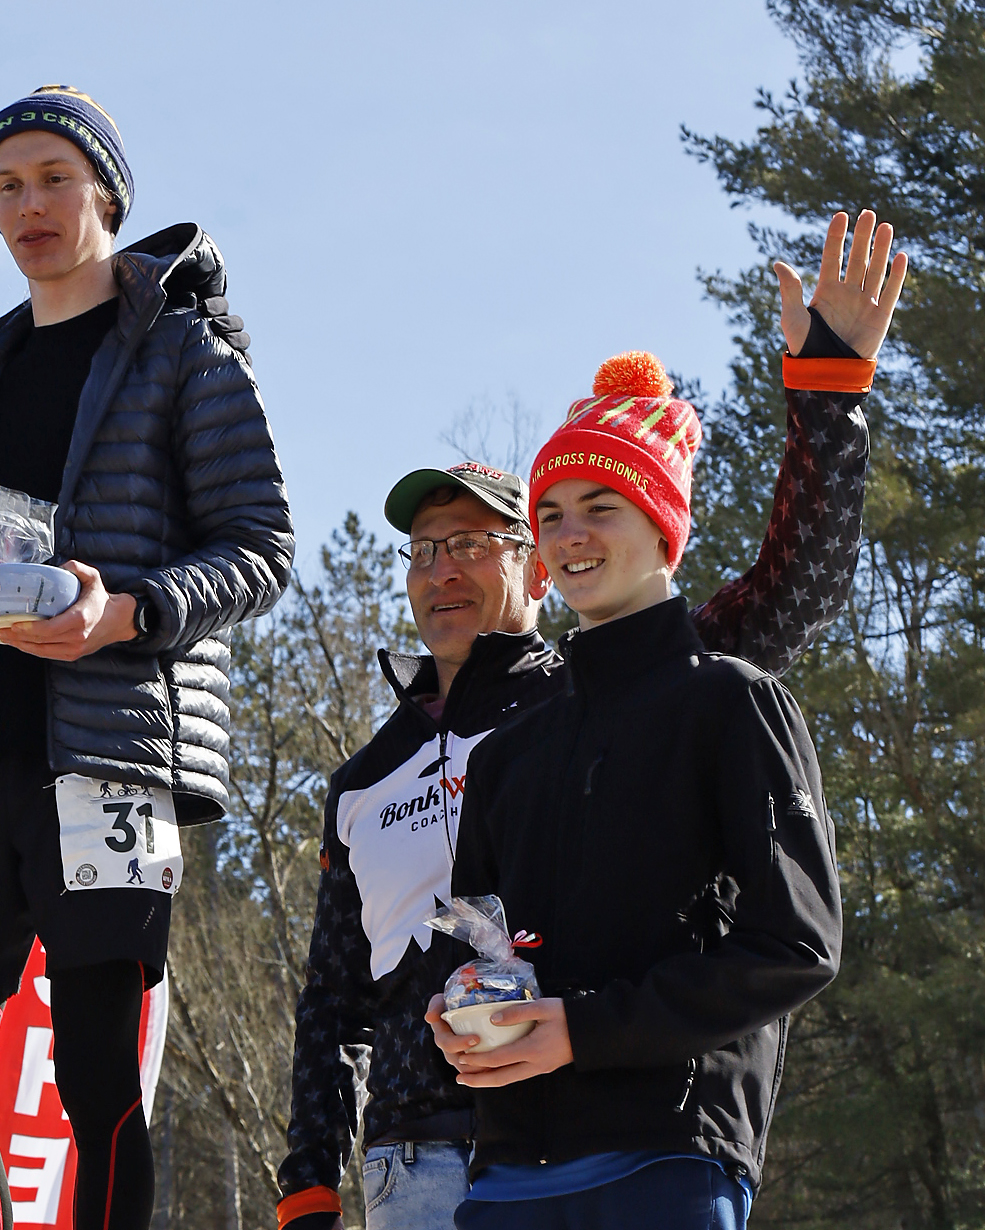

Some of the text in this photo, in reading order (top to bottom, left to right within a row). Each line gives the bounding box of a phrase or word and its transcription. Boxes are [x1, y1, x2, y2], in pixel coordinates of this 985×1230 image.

[548, 452, 585, 471] CROSS
[588, 453, 649, 491] REGIONALS
[102, 802, 154, 853] 31
